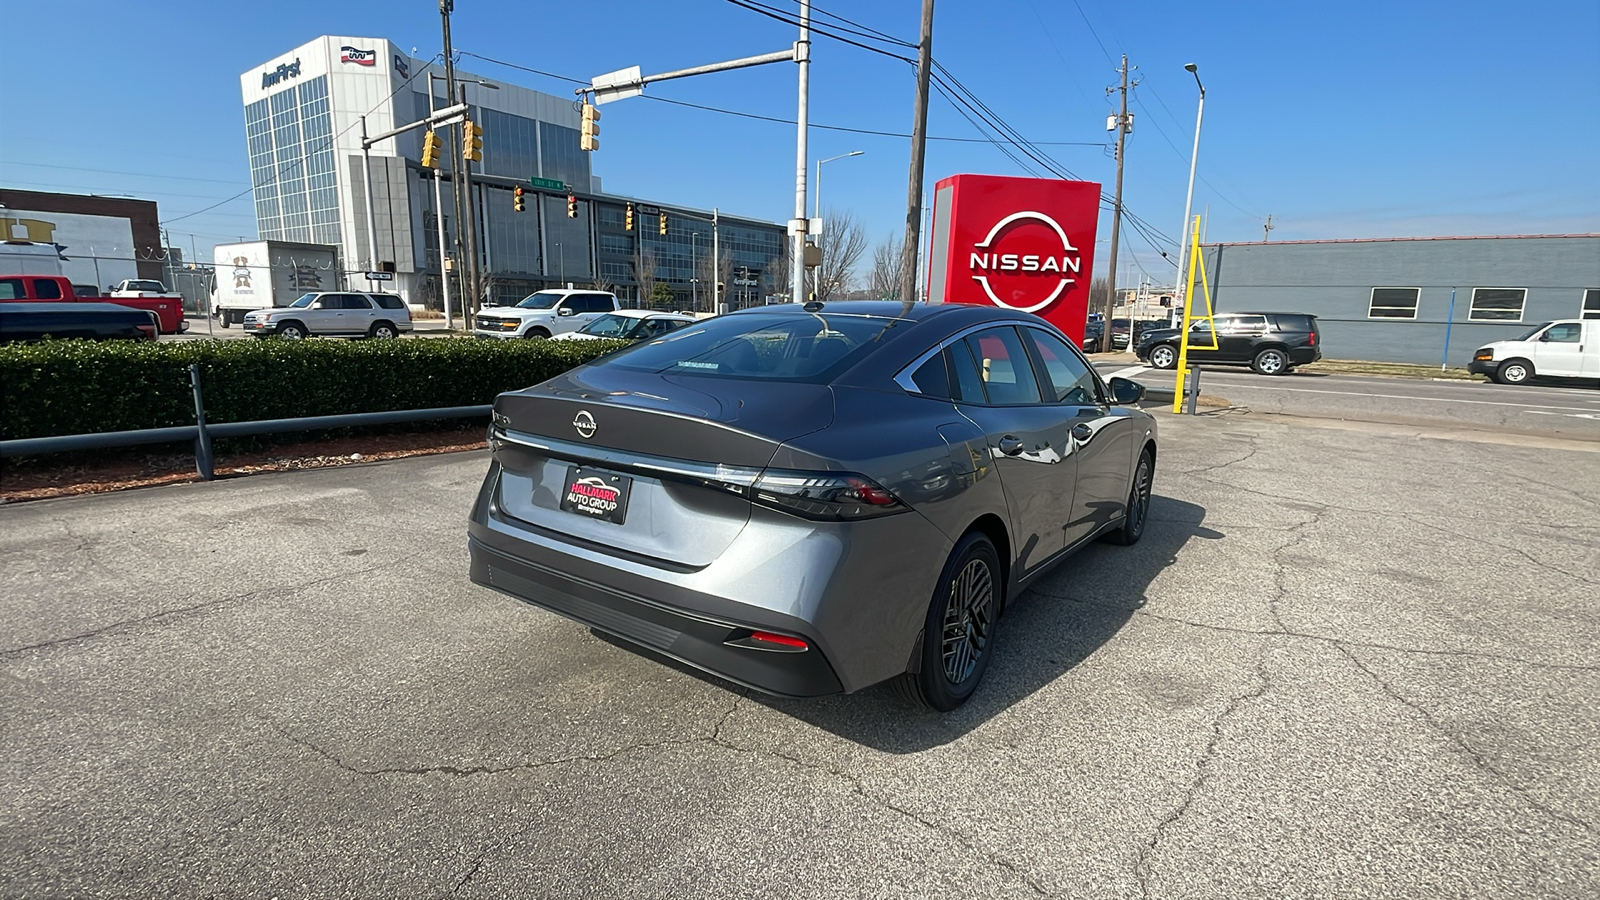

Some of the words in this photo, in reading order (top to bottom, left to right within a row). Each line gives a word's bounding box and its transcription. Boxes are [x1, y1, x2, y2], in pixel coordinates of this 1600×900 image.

[262, 57, 301, 90] AmFirst
[970, 252, 1080, 273] NISSAN
[572, 420, 597, 430] NISSAN
[567, 492, 589, 505] AUTO
[589, 497, 618, 511] GROUP
[571, 483, 616, 502] HALLMARK
[578, 504, 603, 515] Birmingham
